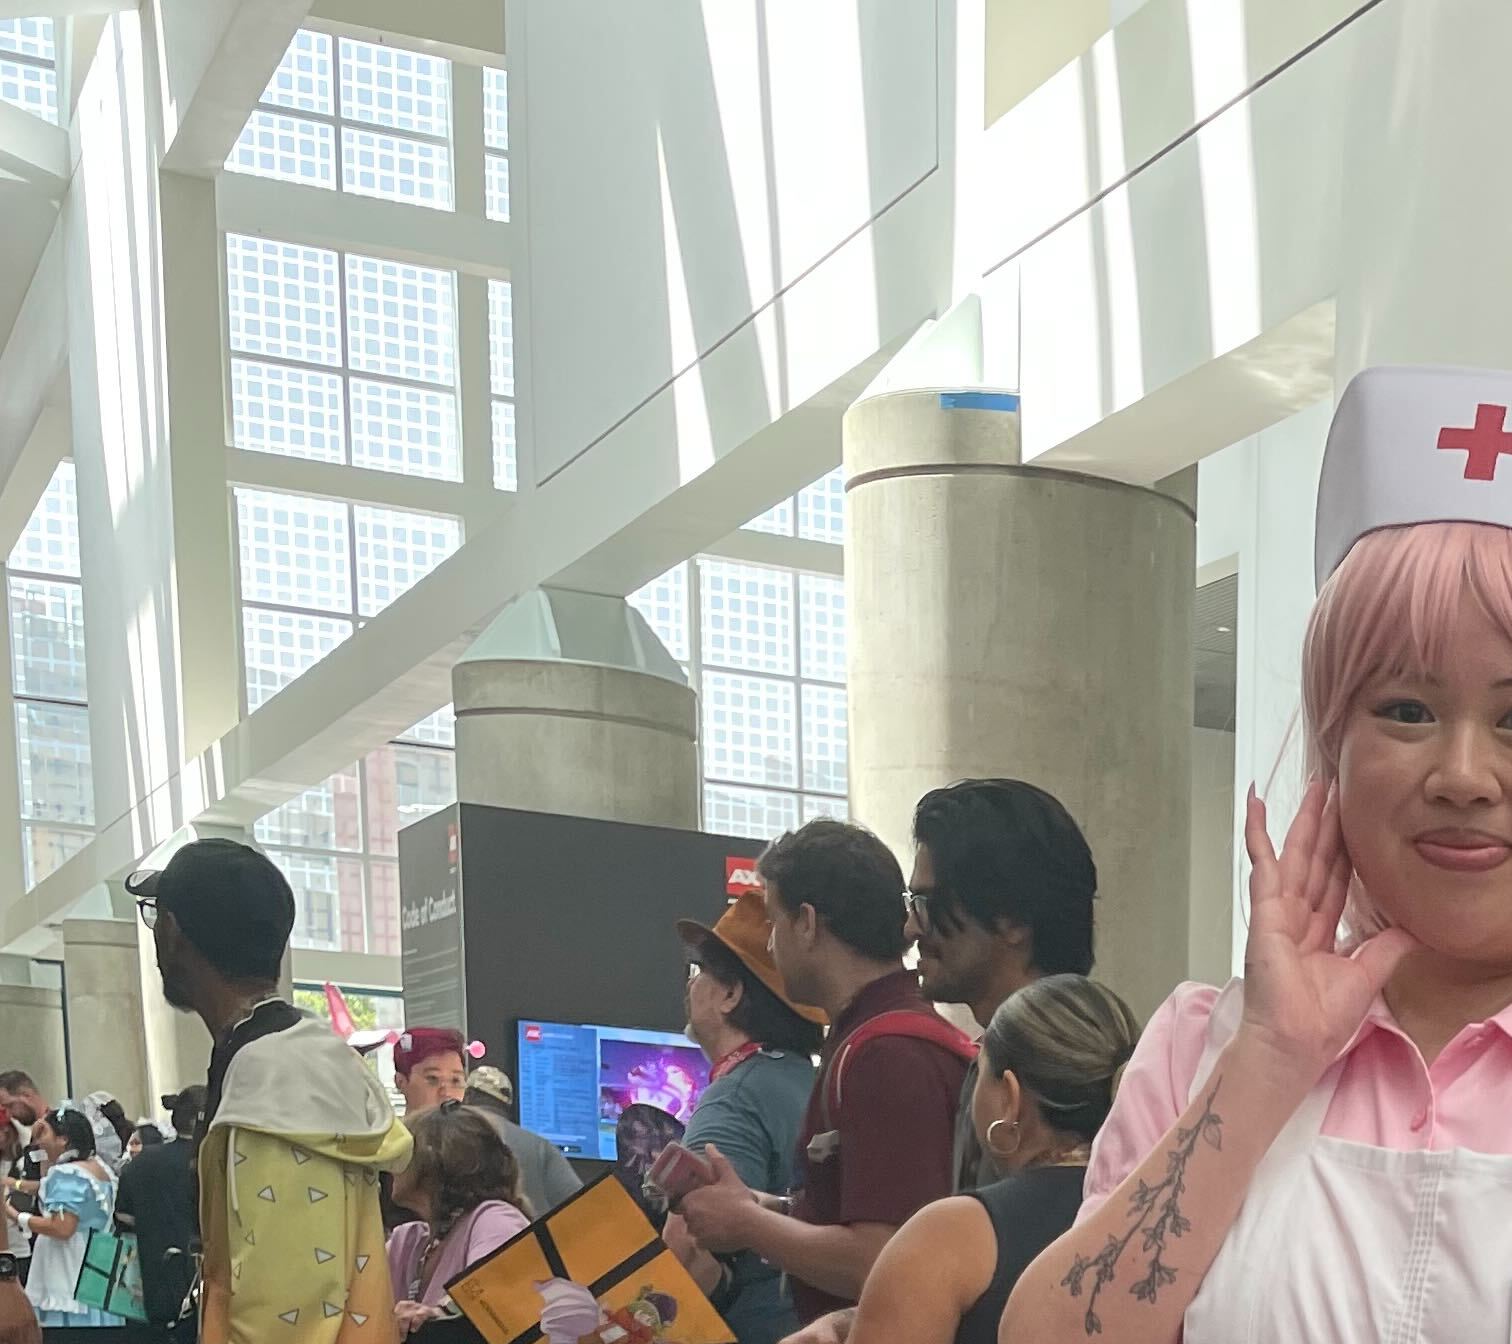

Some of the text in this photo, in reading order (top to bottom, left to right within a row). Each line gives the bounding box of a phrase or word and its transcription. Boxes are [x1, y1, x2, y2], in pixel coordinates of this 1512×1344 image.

[403, 889, 456, 930] Code of Conduct
